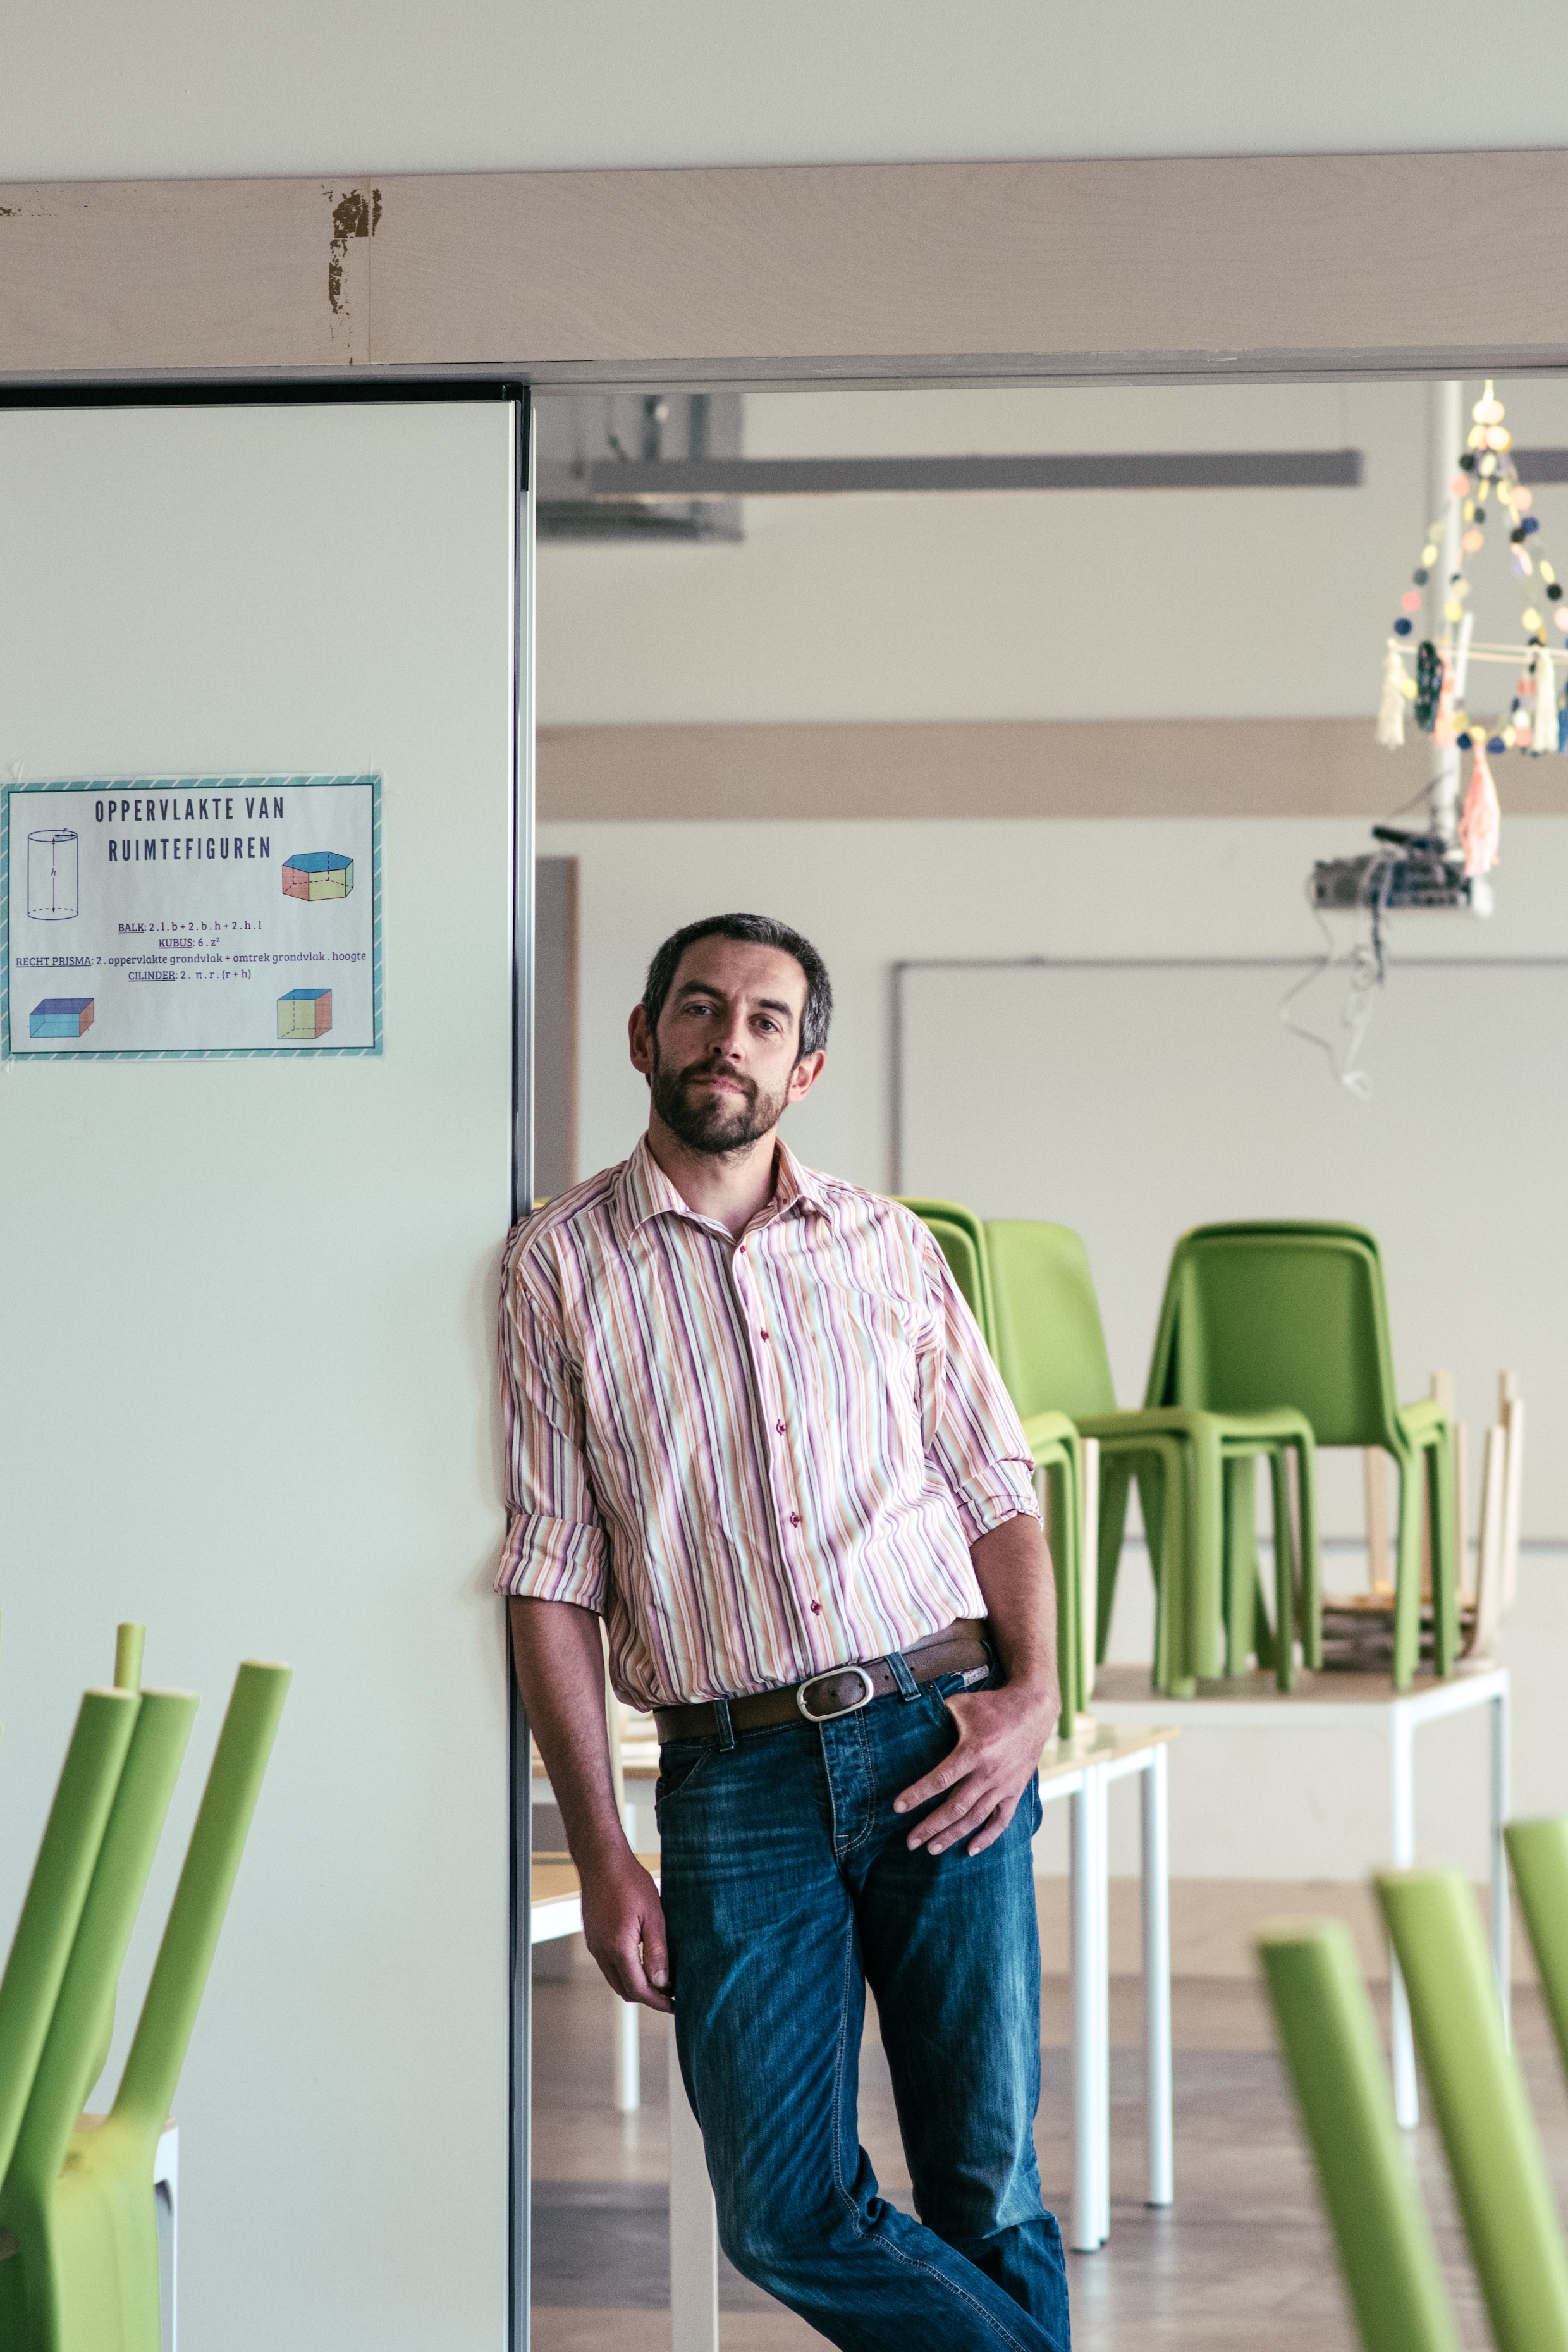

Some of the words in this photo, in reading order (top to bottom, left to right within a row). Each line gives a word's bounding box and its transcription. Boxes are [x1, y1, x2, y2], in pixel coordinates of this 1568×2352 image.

[95, 797, 233, 823] OPPERVLAKTE
[245, 797, 283, 819] VAN
[109, 836, 269, 862] RUIMTEFIGUREN
[51, 867, 56, 876] h
[118, 923, 147, 933] BALK:
[158, 938, 195, 948] KUBUS:
[197, 938, 204, 947] 6
[16, 957, 50, 967] RECHT
[52, 956, 94, 967] PRISMA:
[96, 956, 102, 965] 2
[108, 954, 168, 967] oppervlakte
[169, 953, 223, 966] grondvlak
[233, 953, 270, 962] omtrek
[272, 952, 325, 964] grondvlak
[332, 951, 366, 963] hoogte
[128, 971, 178, 981] CILINDER:
[180, 971, 186, 979] 2
